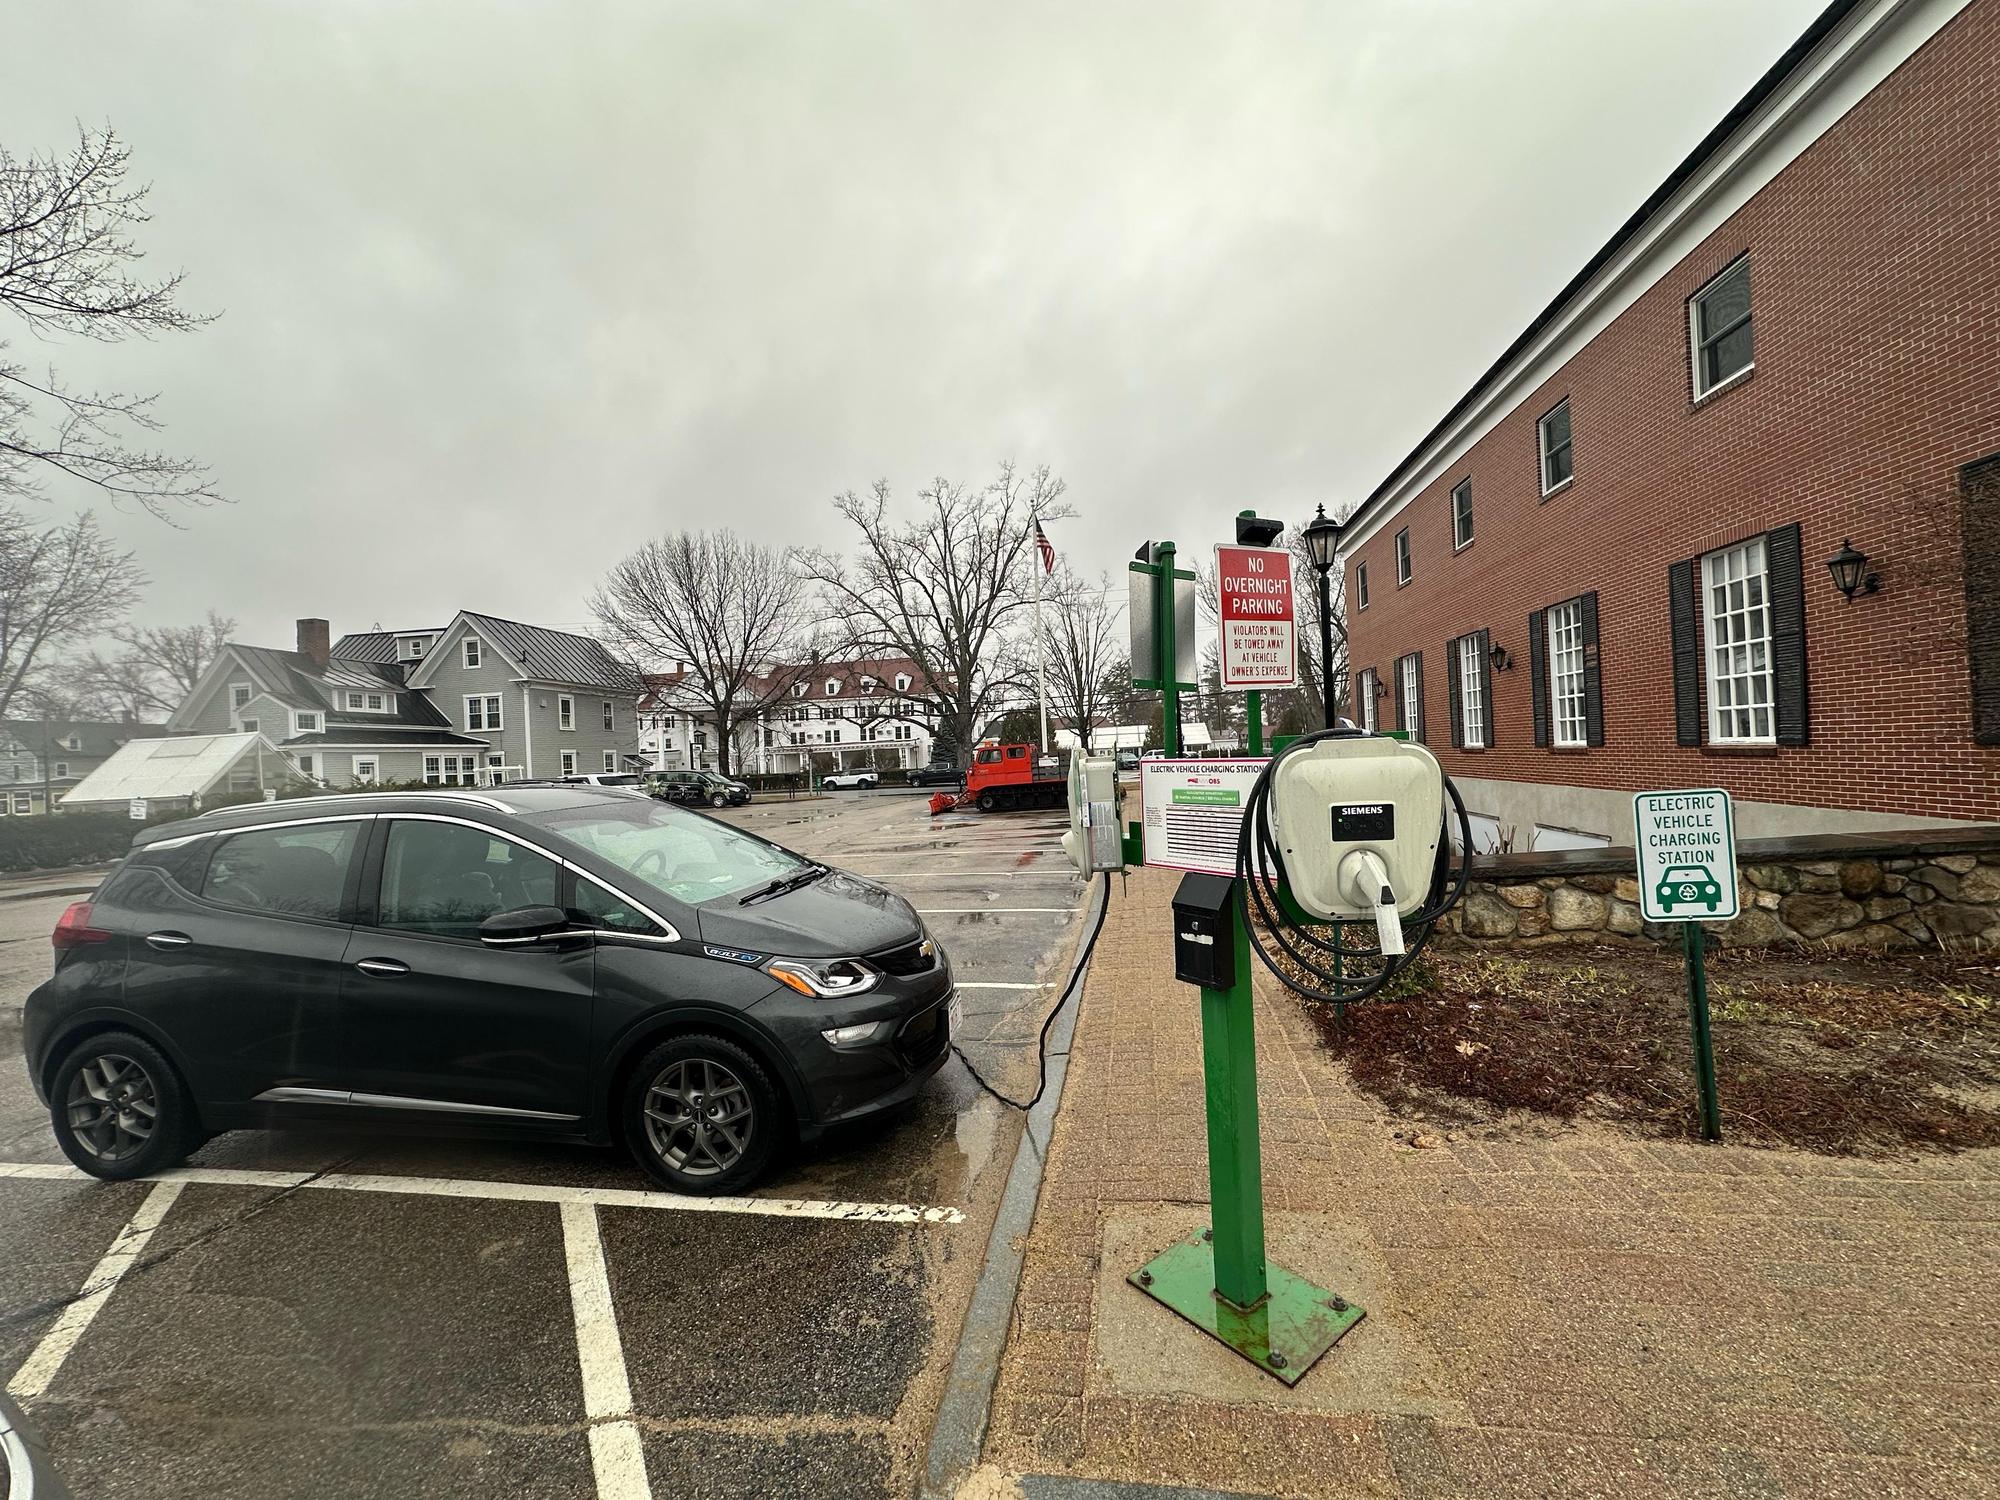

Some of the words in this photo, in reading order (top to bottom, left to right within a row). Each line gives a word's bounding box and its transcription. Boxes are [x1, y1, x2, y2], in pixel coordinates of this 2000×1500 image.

[1248, 557, 1264, 573] NO
[1224, 576, 1288, 595] OVERNIGHT
[1232, 598, 1283, 615] PARKING
[1233, 625, 1268, 636] VIOLATORS
[1269, 626, 1284, 636] WILL
[1234, 639, 1242, 649] BE
[1244, 639, 1265, 649] TOWED
[1267, 639, 1285, 649] AWAY
[1242, 653, 1250, 663] AT
[1251, 653, 1277, 663] VEHICLE
[1231, 666, 1260, 677] OWNER'S
[1262, 666, 1288, 677] EXPENSE
[1150, 765, 1175, 773] ELECTRIC
[1176, 765, 1200, 773] VEHICLE
[1201, 765, 1235, 774] CHARGING
[1341, 806, 1383, 815] SIEMENS
[1649, 796, 1715, 811] ELECTRIC
[1653, 814, 1713, 829] VEHICLE
[1649, 832, 1721, 847] CHARGING
[1658, 850, 1715, 864] STATION
